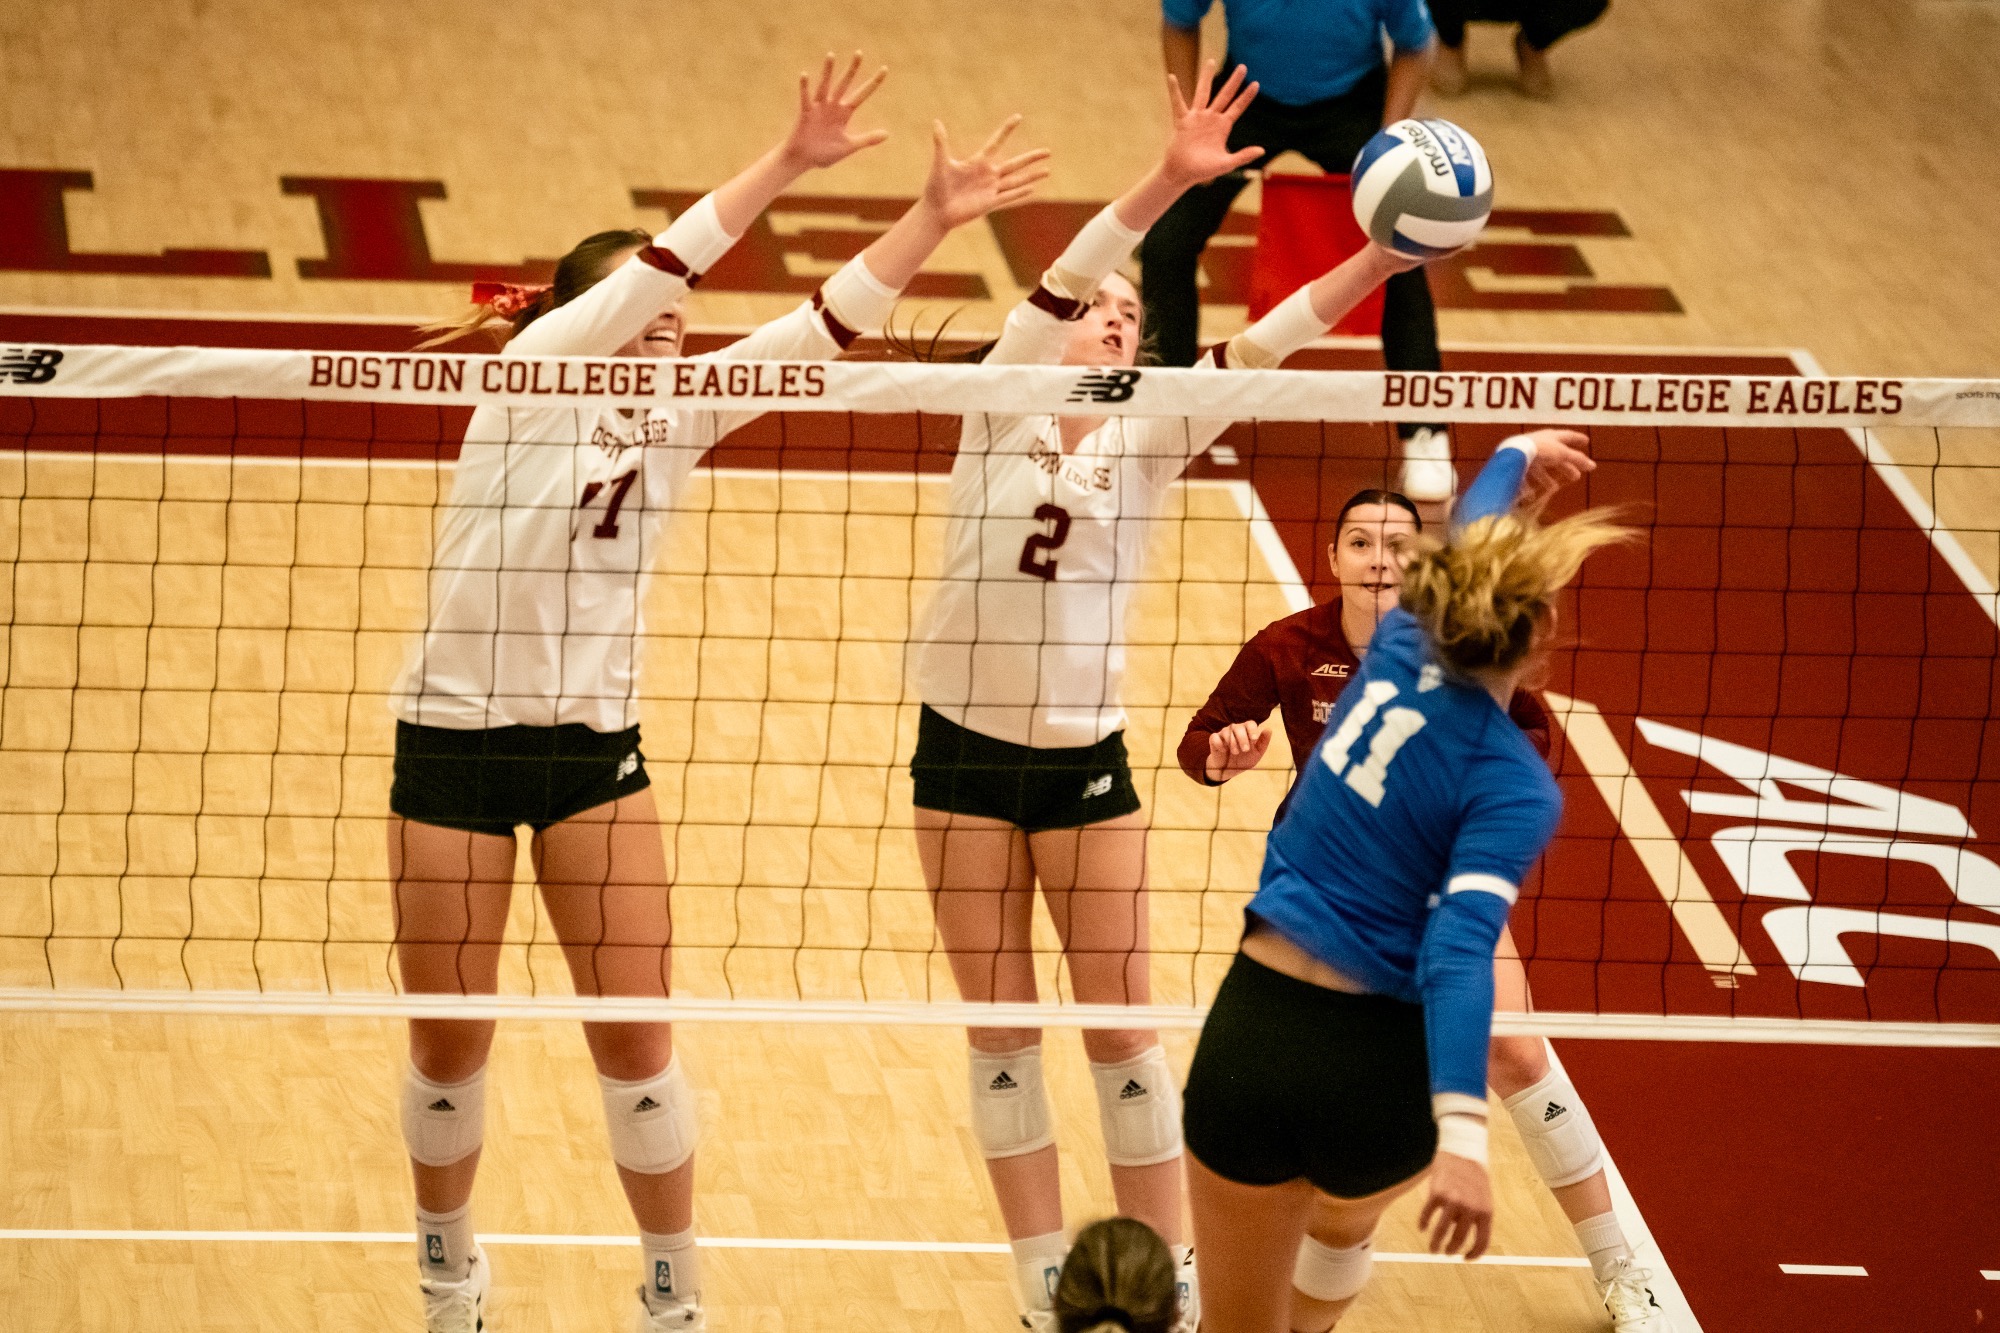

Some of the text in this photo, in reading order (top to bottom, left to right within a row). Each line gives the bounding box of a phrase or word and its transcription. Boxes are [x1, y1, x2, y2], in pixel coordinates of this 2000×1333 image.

[309, 355, 826, 397] BOSTON COLLEGE EAGLES
[1382, 375, 1903, 414] BOSTON COLLEGE EAGLES
[1019, 503, 1071, 582] 2
[1312, 663, 1350, 677] ACC
[1321, 680, 1427, 808] 11
[1544, 1106, 1567, 1122] adidas
